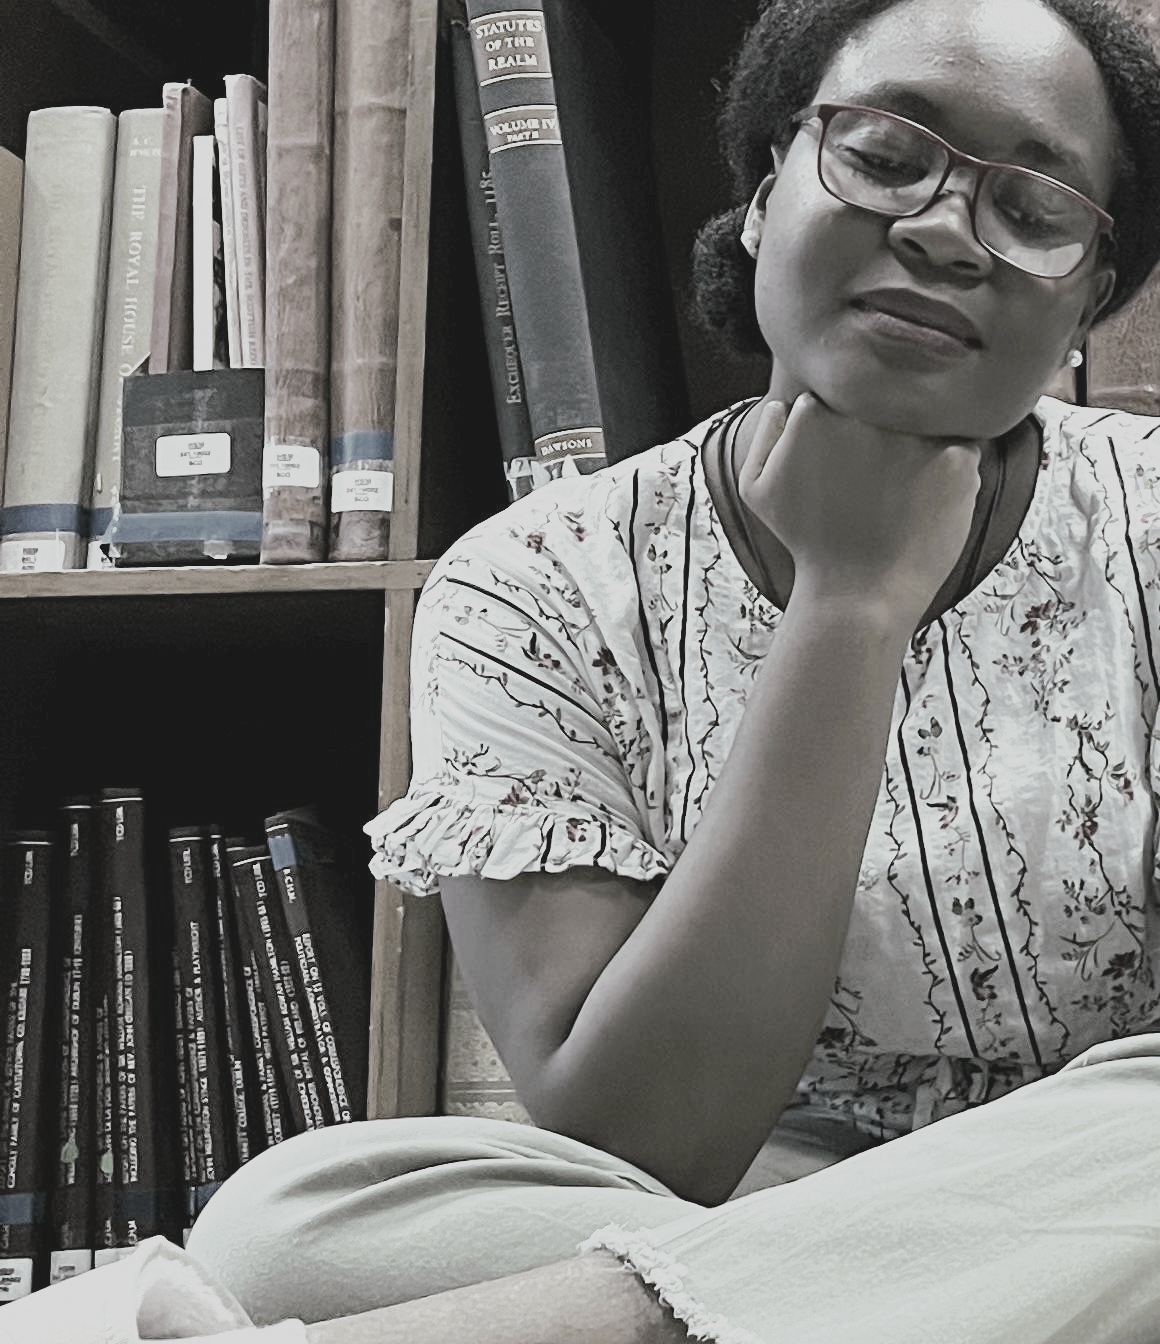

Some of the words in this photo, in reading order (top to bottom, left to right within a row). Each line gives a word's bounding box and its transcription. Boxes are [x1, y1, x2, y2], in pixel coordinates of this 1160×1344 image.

[475, 19, 543, 40] STATUTES
[485, 40, 502, 52] OF
[504, 36, 535, 49] THE
[488, 54, 538, 71] REALM
[489, 118, 540, 136] VOLUME
[131, 185, 146, 222] THE
[124, 231, 143, 288] ROYAL
[119, 297, 139, 356] HOUSE
[540, 438, 593, 456] DAWSONS
[190, 921, 200, 974] PLAYWRIGHT
[243, 966, 251, 976] OF
[72, 981, 80, 1010] DUBLIN
[310, 966, 319, 980] ON
[322, 1021, 332, 1033] OF
[72, 1014, 79, 1024] OF
[296, 1038, 307, 1048] OF
[127, 1073, 136, 1084] OF
[293, 1069, 303, 1079] OF
[12, 1102, 20, 1113] OF
[127, 1087, 136, 1116] PAPERS
[10, 1116, 19, 1146] FAMILY
[128, 1118, 136, 1134] THE
[206, 1157, 215, 1180] JOHN
